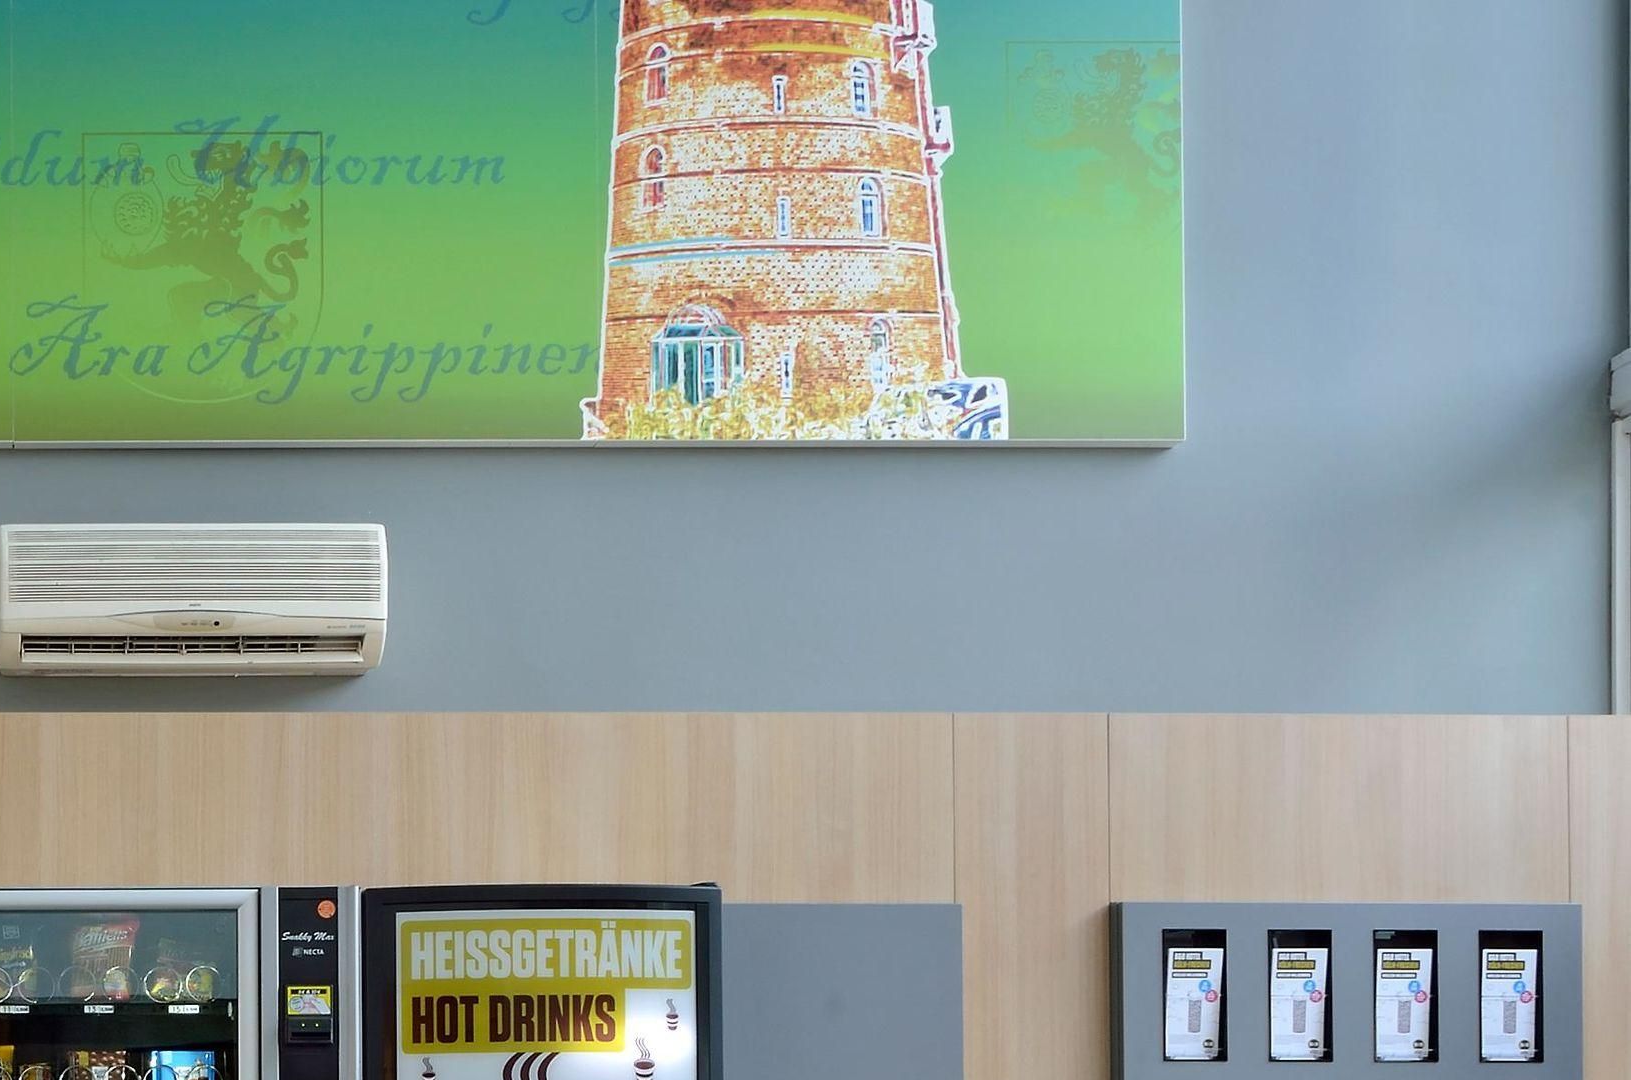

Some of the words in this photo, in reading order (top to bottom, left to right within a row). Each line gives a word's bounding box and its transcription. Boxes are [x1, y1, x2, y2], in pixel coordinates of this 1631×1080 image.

[171, 114, 505, 188] Ubiorum
[8, 293, 169, 380] Ara
[303, 948, 324, 956] NECTA
[410, 921, 682, 981] HEISSGETRÄNKE
[412, 994, 479, 1044] HOT
[489, 993, 616, 1043] DRINKS
